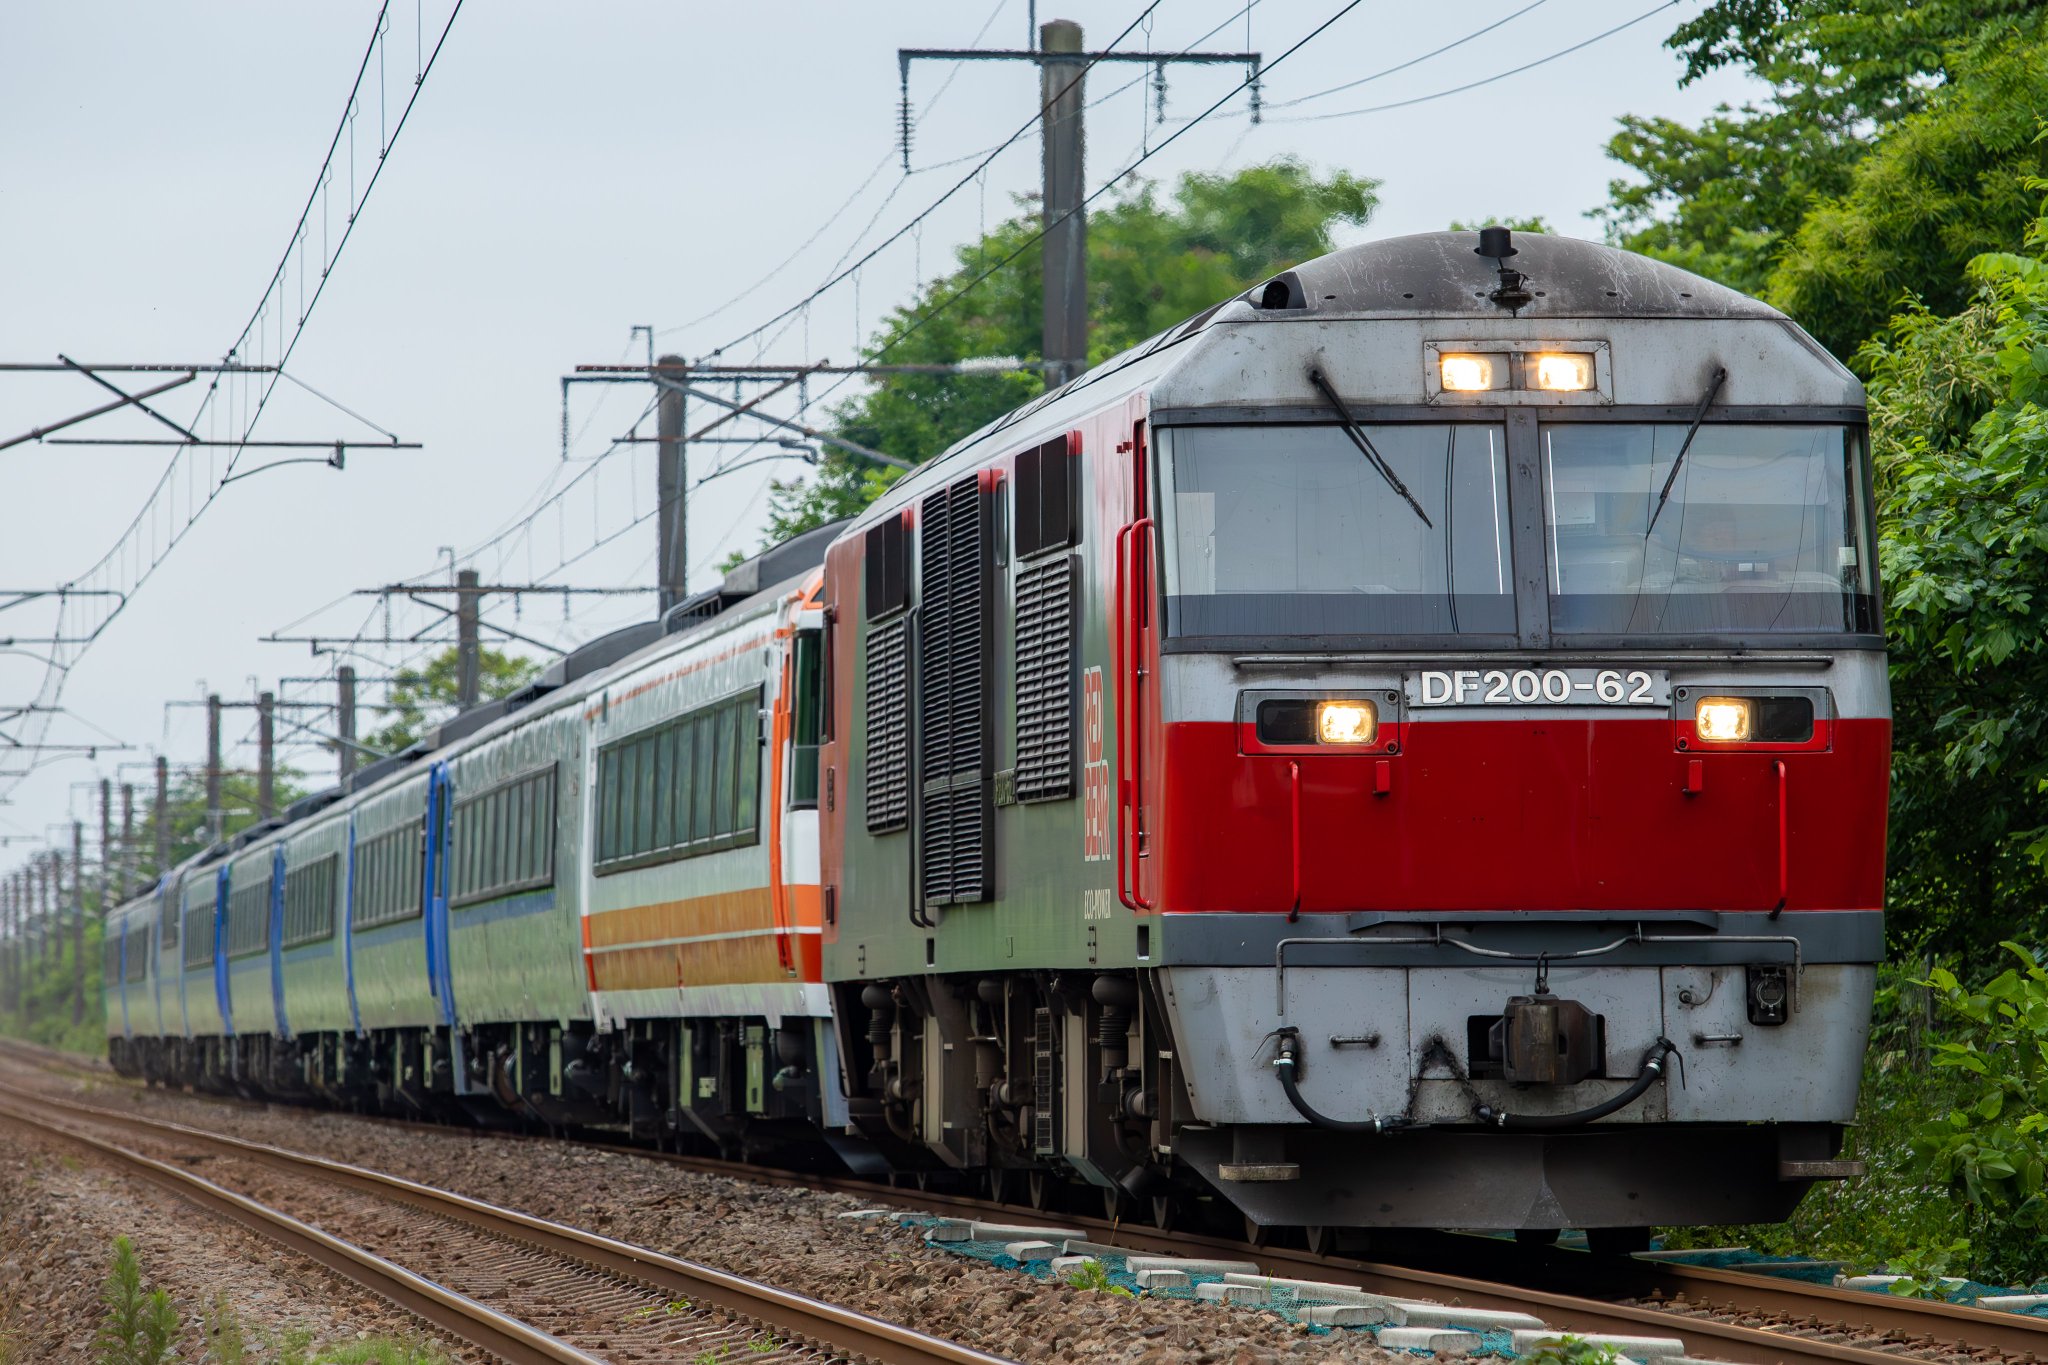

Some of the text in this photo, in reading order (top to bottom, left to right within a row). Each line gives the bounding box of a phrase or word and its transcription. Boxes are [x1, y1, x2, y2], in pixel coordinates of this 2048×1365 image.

[1084, 665, 1103, 767] RED
[1420, 670, 1655, 704] DF200-62
[1084, 759, 1111, 861] BEAR
